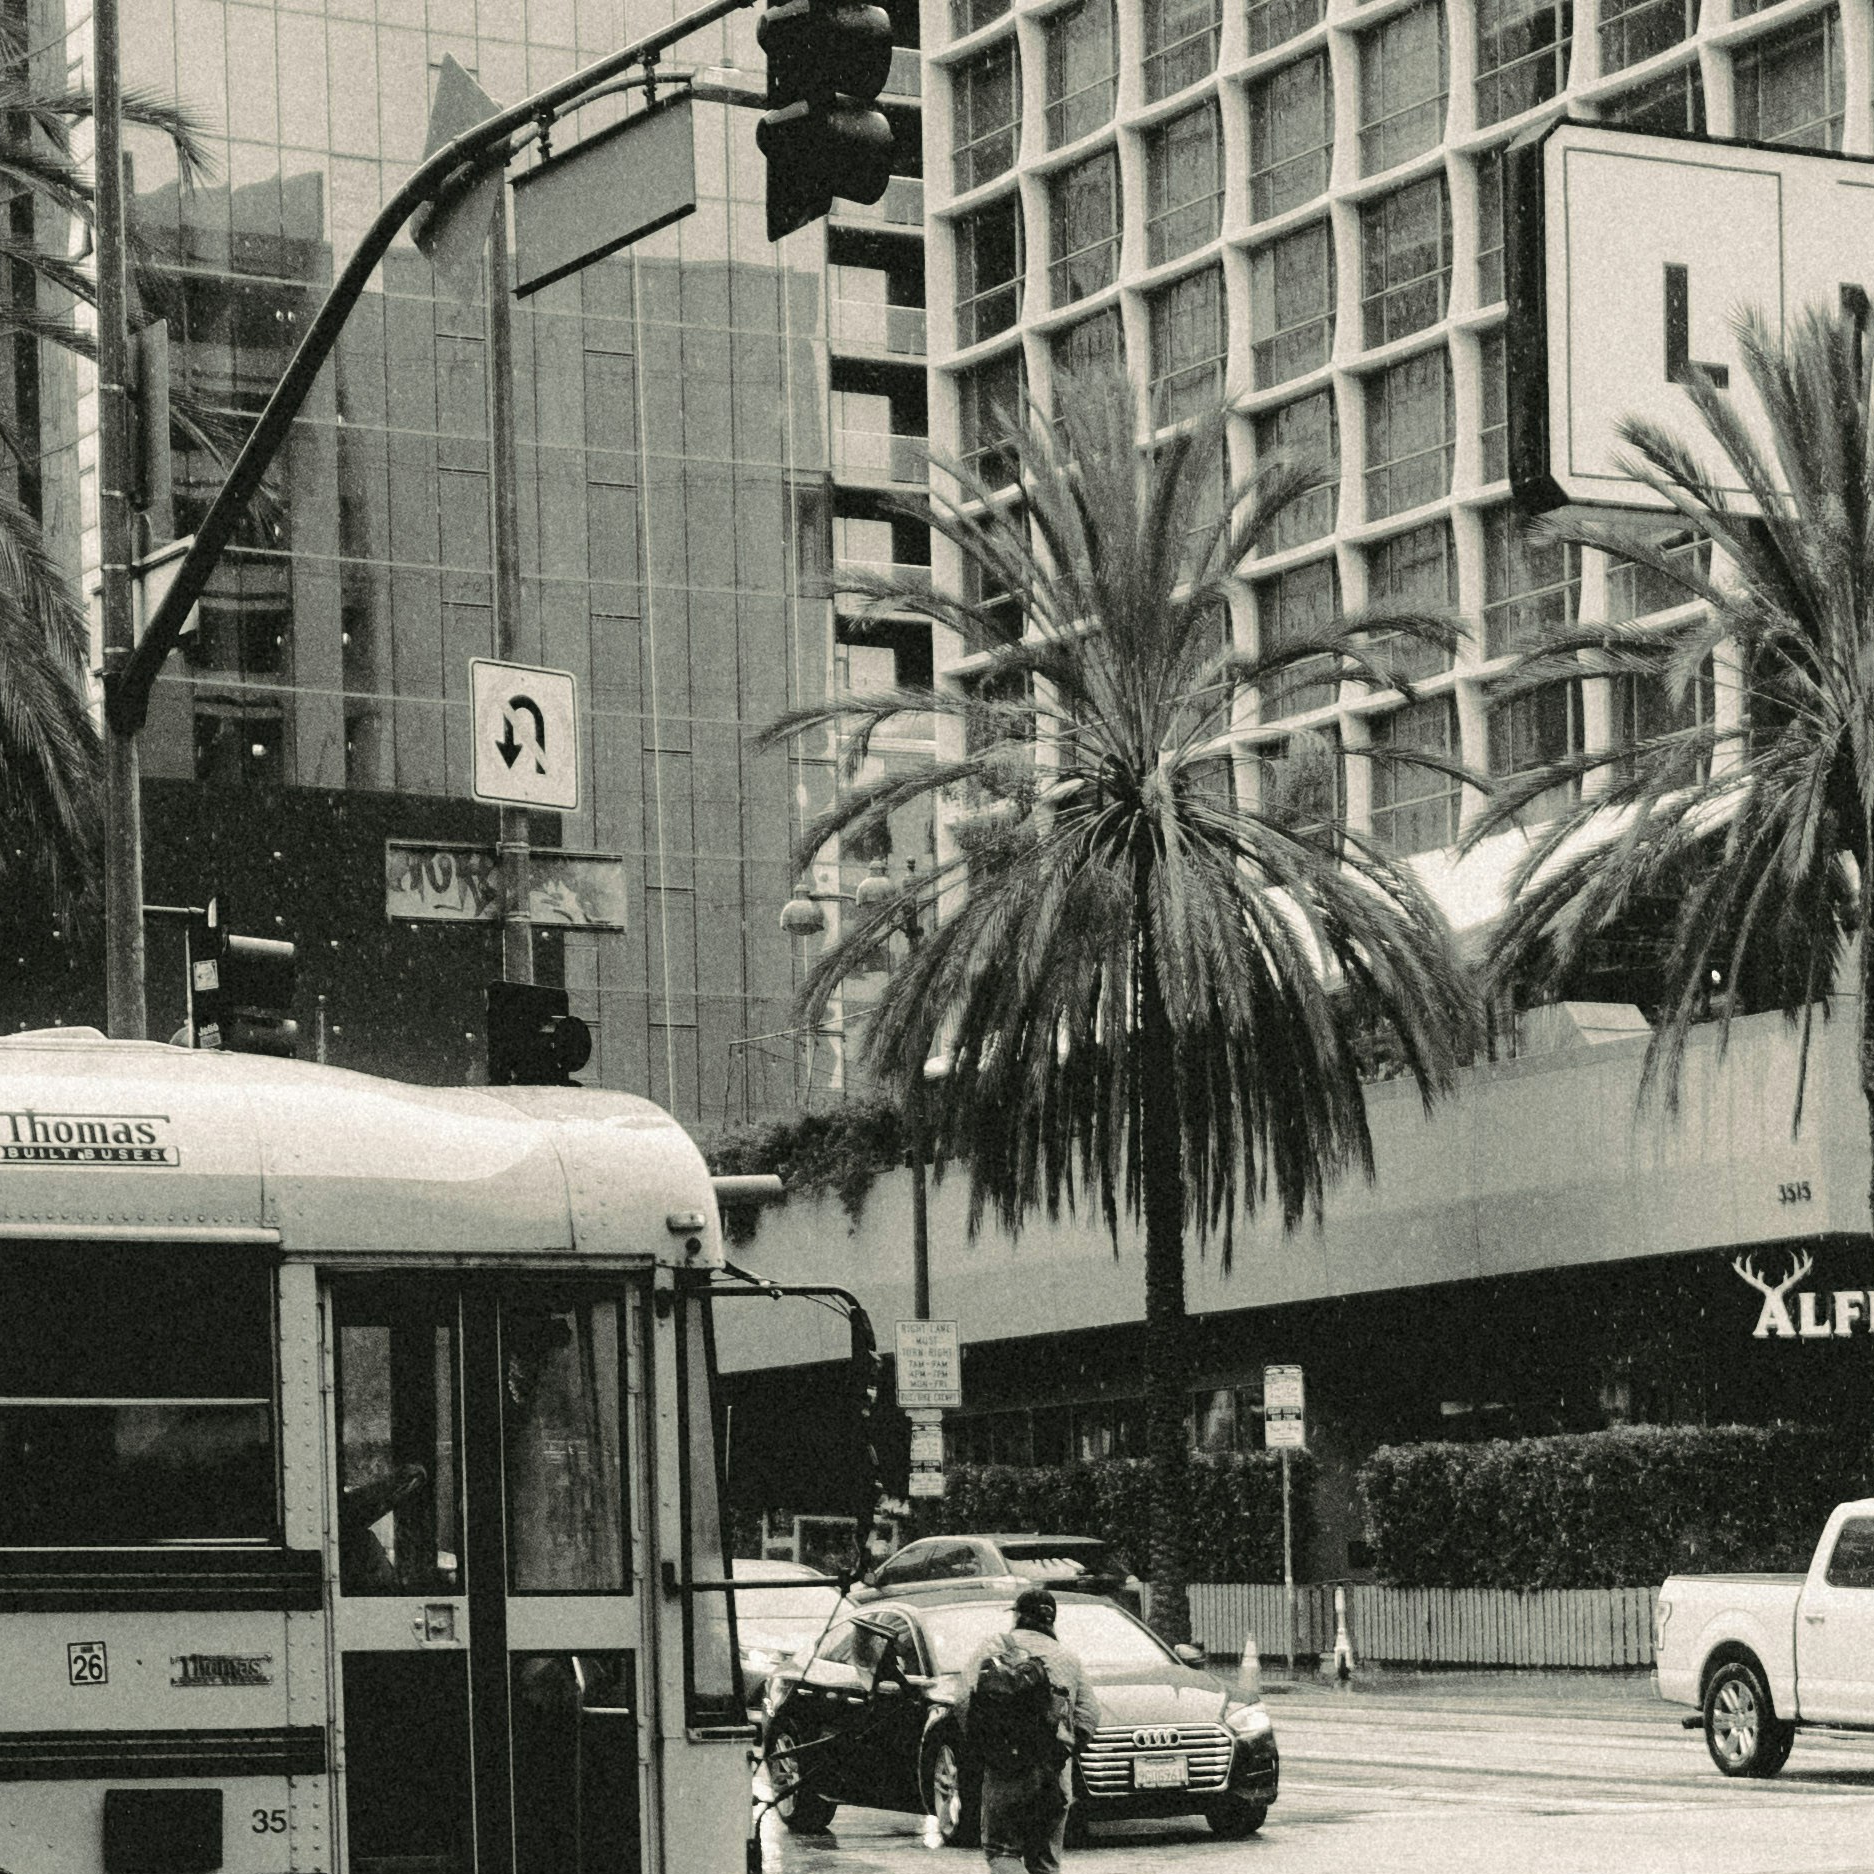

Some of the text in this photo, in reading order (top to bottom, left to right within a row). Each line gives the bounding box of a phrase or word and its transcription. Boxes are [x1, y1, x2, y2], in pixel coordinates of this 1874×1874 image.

[7, 1147, 160, 1161] BUILT BUSES
[901, 1323, 952, 1334] RIGHT LANE
[915, 1336, 938, 1346] MUST
[902, 1347, 952, 1358] TURN RIGHT
[73, 1654, 103, 1681] 26
[252, 1809, 287, 1833] 35
